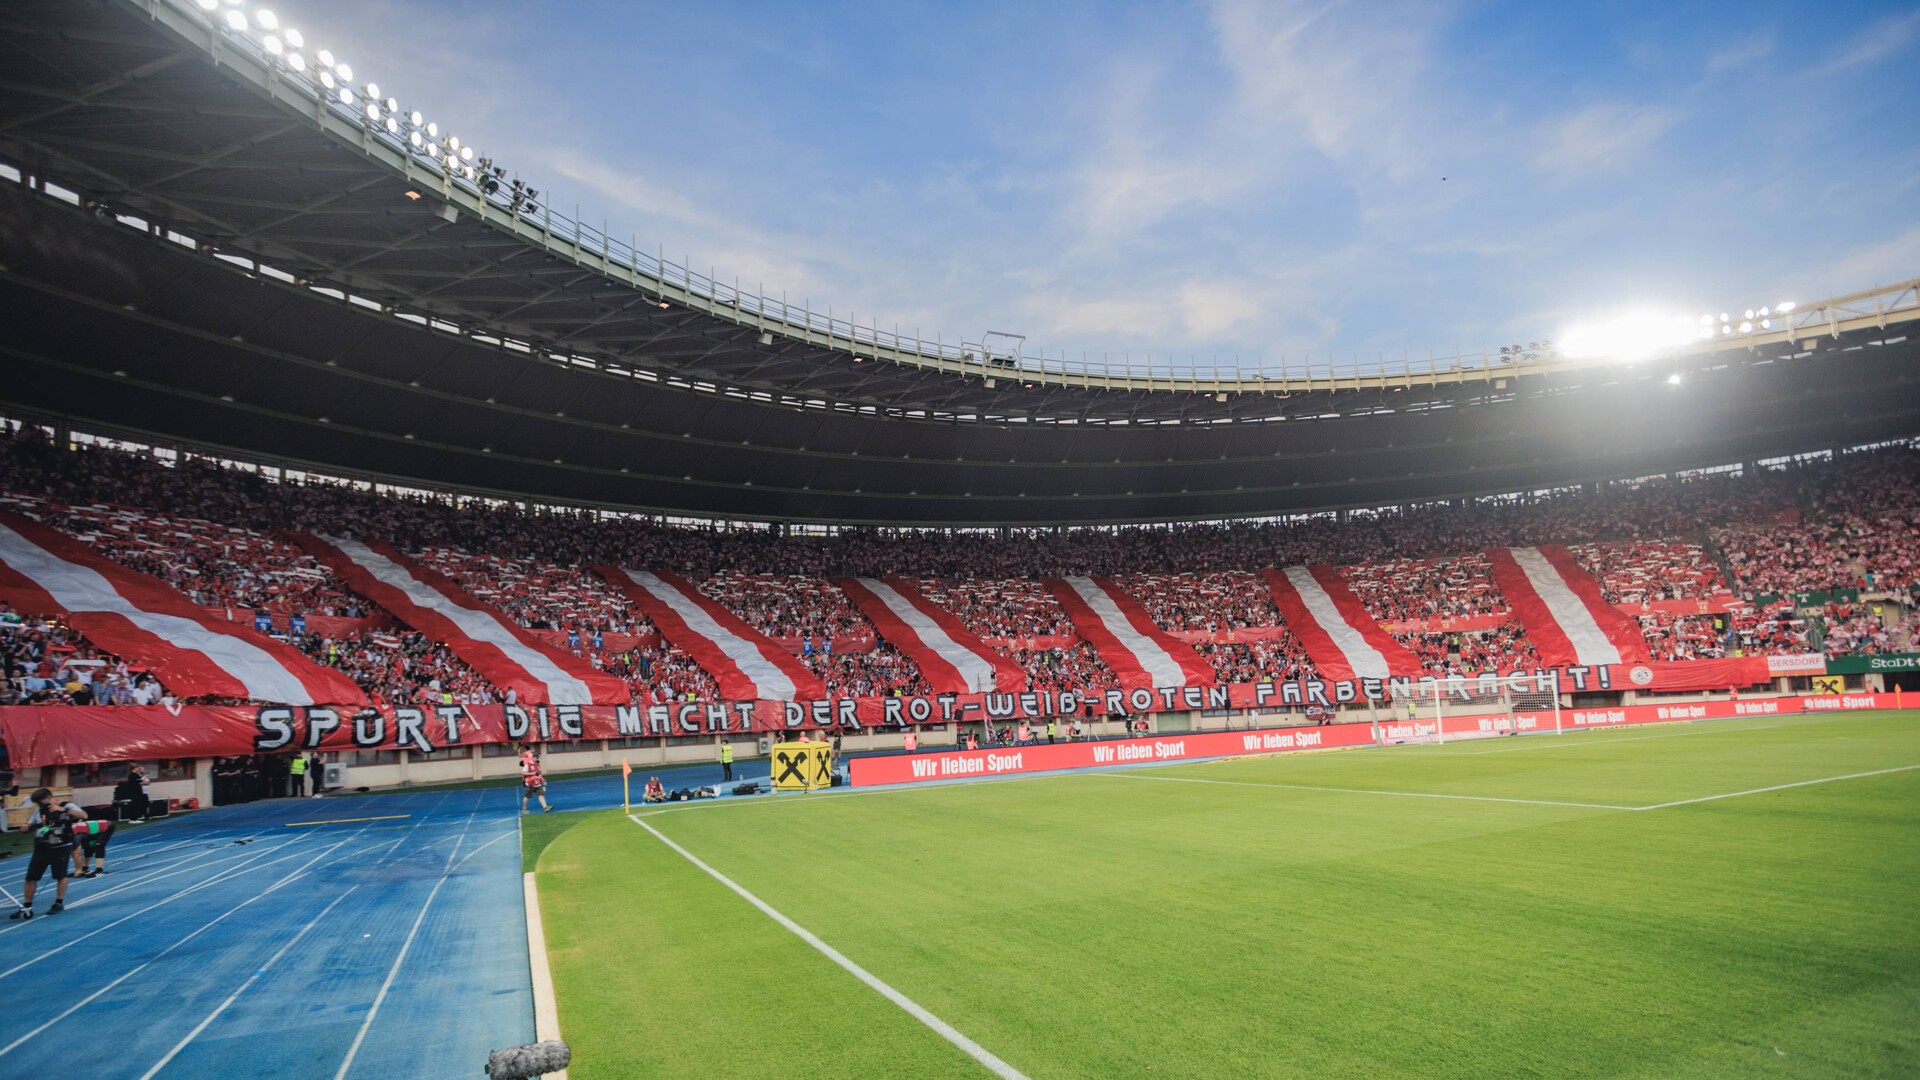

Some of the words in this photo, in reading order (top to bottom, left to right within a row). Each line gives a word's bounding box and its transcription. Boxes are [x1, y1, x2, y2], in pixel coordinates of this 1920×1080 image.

[1769, 657, 1820, 667] GERSDORF
[1843, 696, 1875, 708] Sport
[504, 705, 583, 739] DIE
[616, 701, 755, 735] MACHT
[785, 699, 861, 730] DER
[1608, 710, 1626, 723] Sport
[1690, 705, 1706, 718] Sport
[1517, 715, 1537, 729] Sport
[1387, 724, 1412, 738] lieben
[1414, 722, 1436, 736] Sport
[1243, 735, 1261, 750] Wir
[1263, 733, 1294, 749] lieben
[1295, 730, 1322, 748] Sport
[1093, 745, 1115, 762] Wir
[1117, 743, 1153, 760] lieben
[1155, 740, 1185, 758] Sport
[911, 758, 938, 777] Wir
[941, 756, 984, 774] lieben
[987, 752, 1023, 772] Sport
